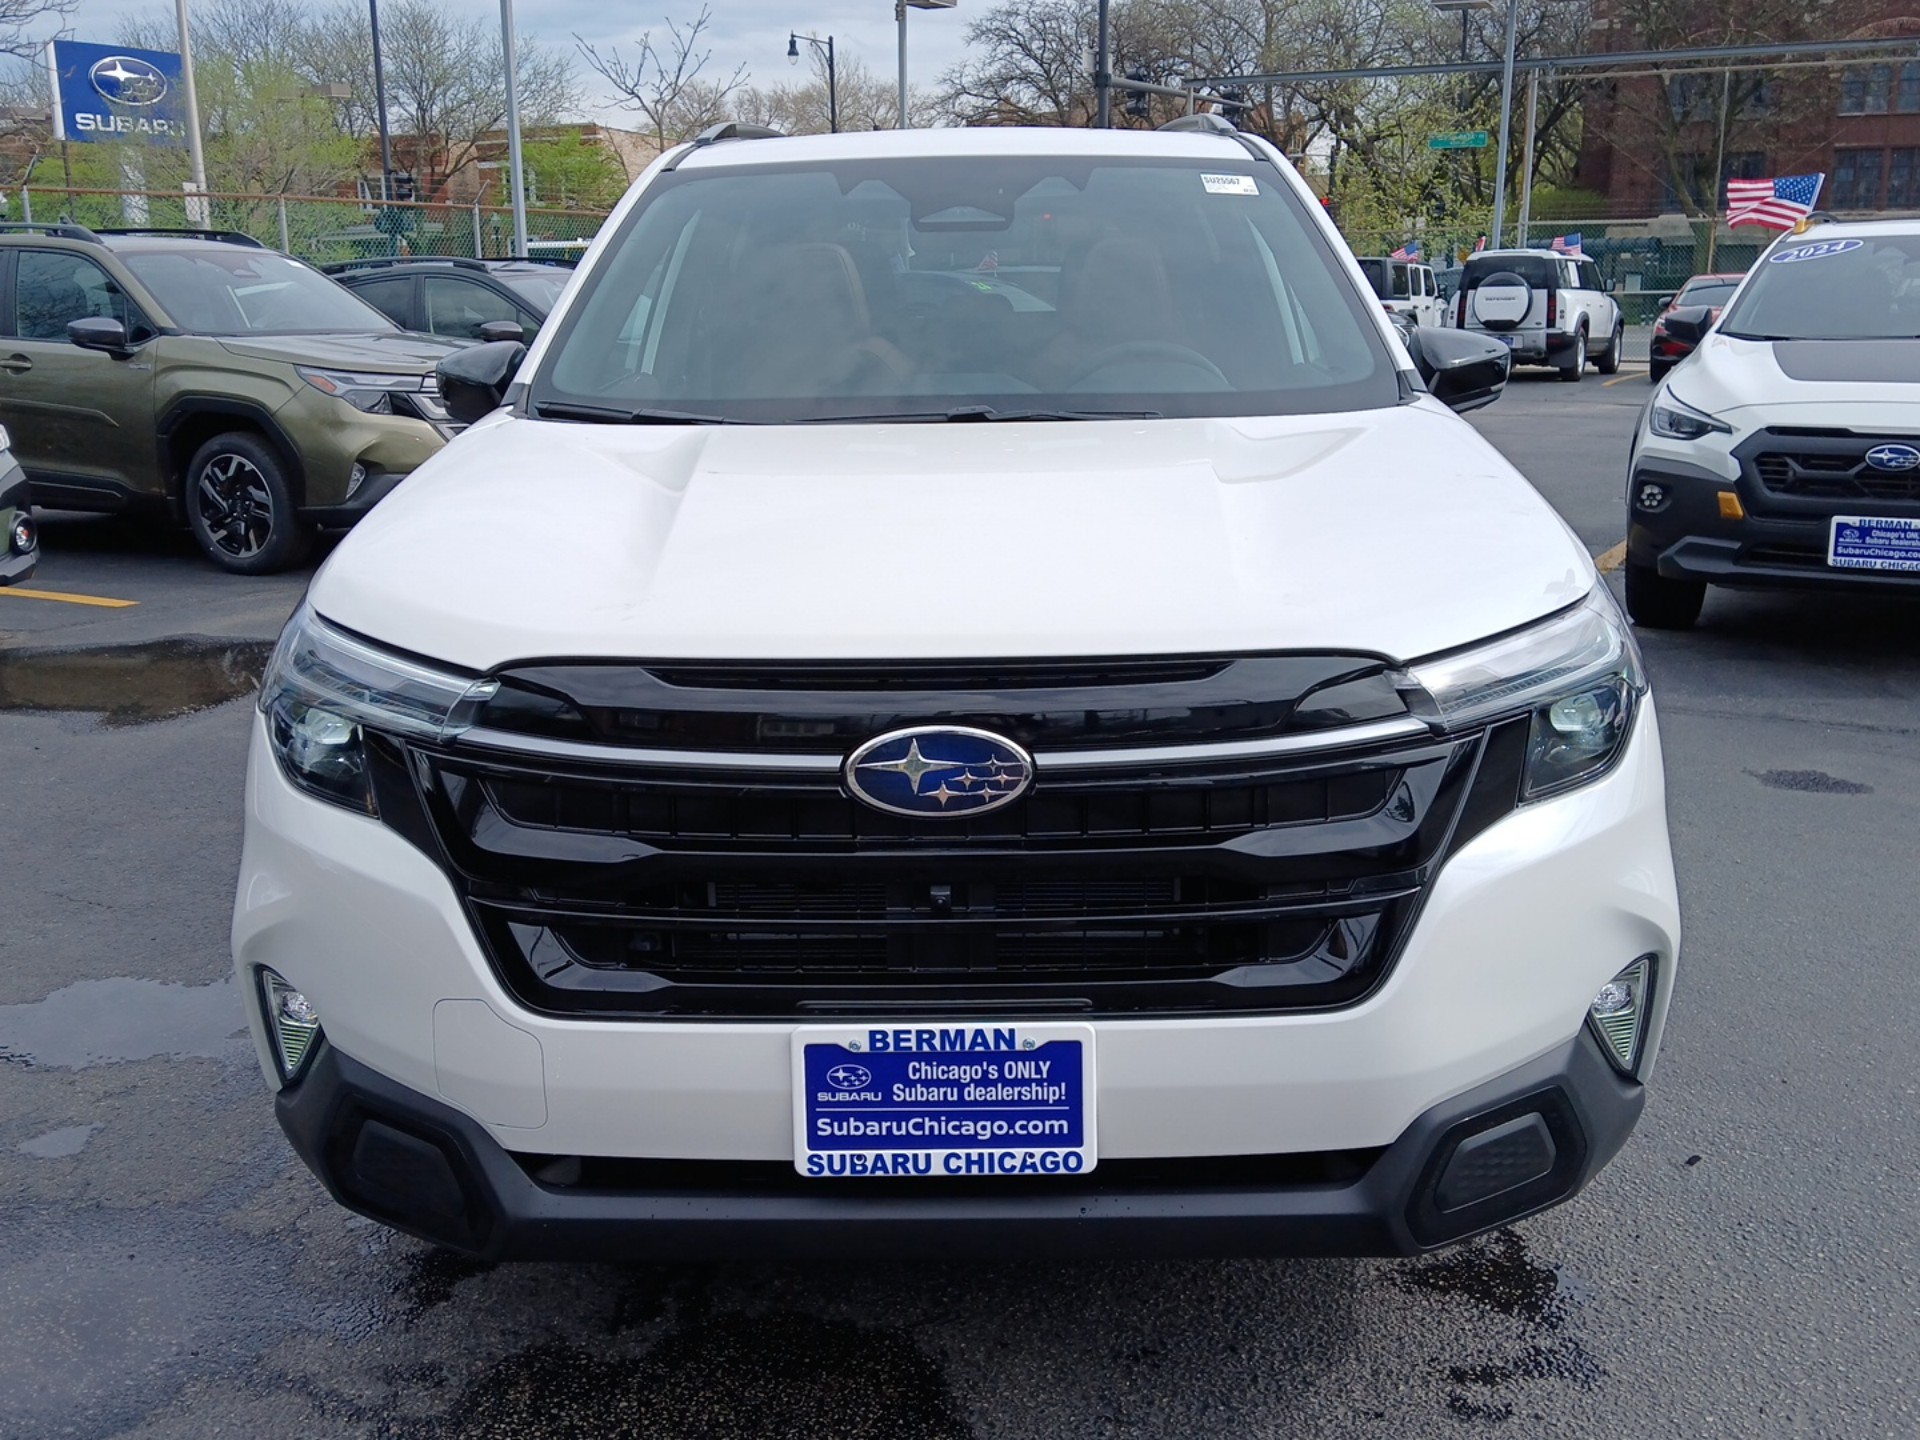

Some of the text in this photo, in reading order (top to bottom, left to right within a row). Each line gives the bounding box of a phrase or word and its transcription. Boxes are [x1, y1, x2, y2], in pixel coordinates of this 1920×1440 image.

[1783, 241, 1848, 262] 2024
[1860, 519, 1912, 529] BERMAN
[1837, 546, 1920, 559] SubaruChicago.co
[1832, 559, 1876, 568] SUBARU
[868, 1028, 1016, 1051] BERMAN
[908, 1060, 1051, 1083] Chicago's ONLY
[817, 1091, 882, 1102] SUBARU
[892, 1082, 1066, 1103] Subaru dealership!
[816, 1117, 1069, 1140] SubaruChicago.com
[806, 1151, 1084, 1175] SUBARU CHICAGO
